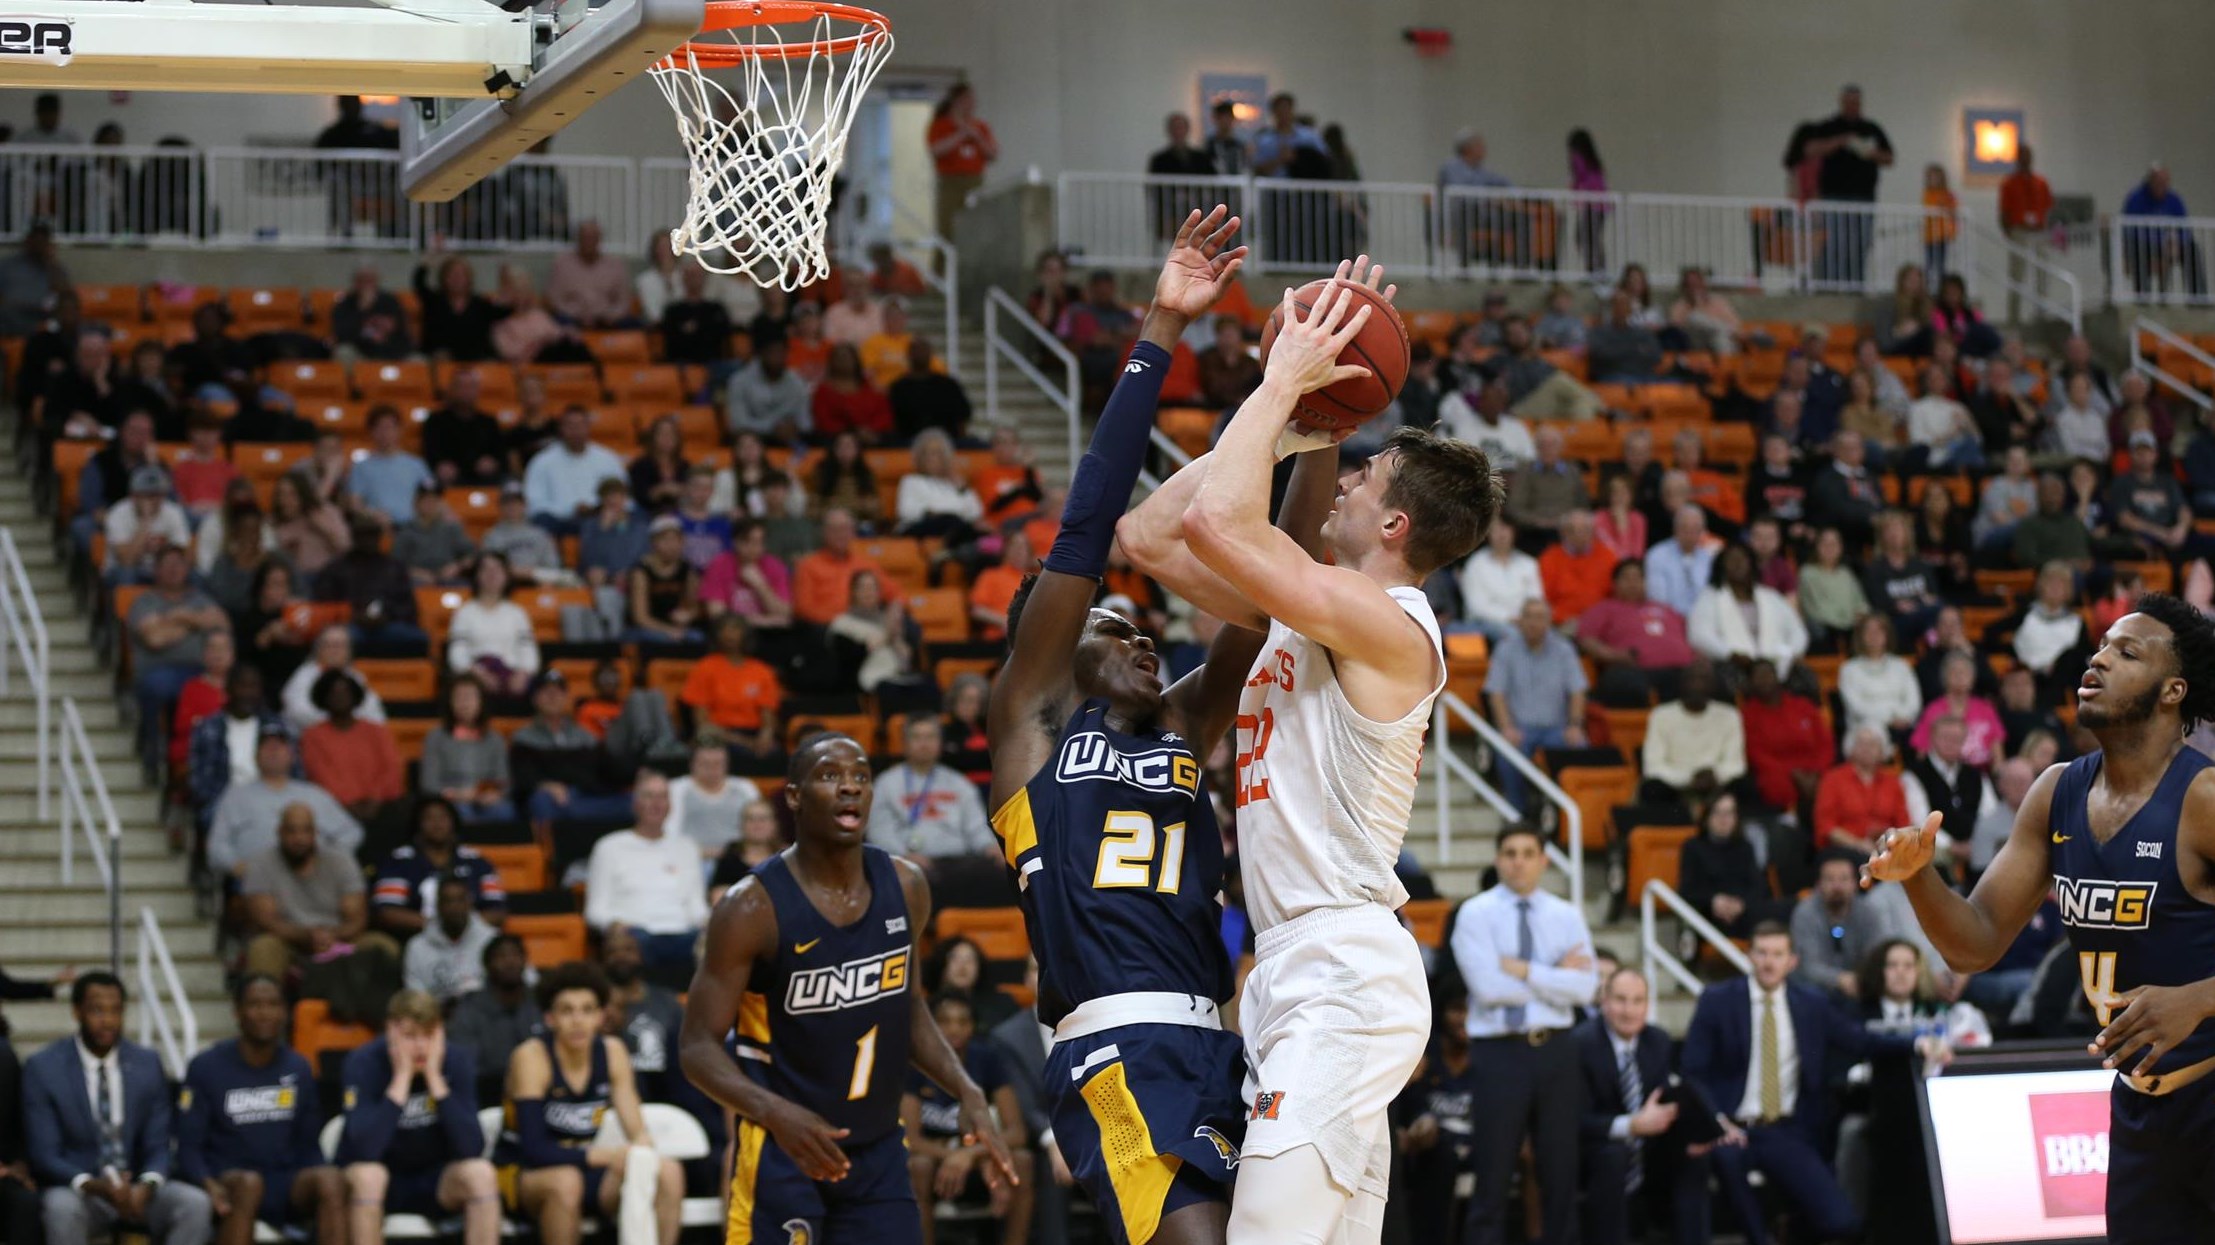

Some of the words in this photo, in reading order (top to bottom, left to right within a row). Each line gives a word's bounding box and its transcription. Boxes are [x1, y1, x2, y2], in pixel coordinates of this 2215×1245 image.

[1060, 736, 1199, 795] UNCG
[1092, 810, 1187, 895] 21
[2135, 841, 2162, 859] SOCON
[2059, 882, 2149, 924] NCG
[788, 950, 909, 1012] UNCG
[2079, 951, 2121, 1027] 4
[848, 1024, 879, 1100] 1
